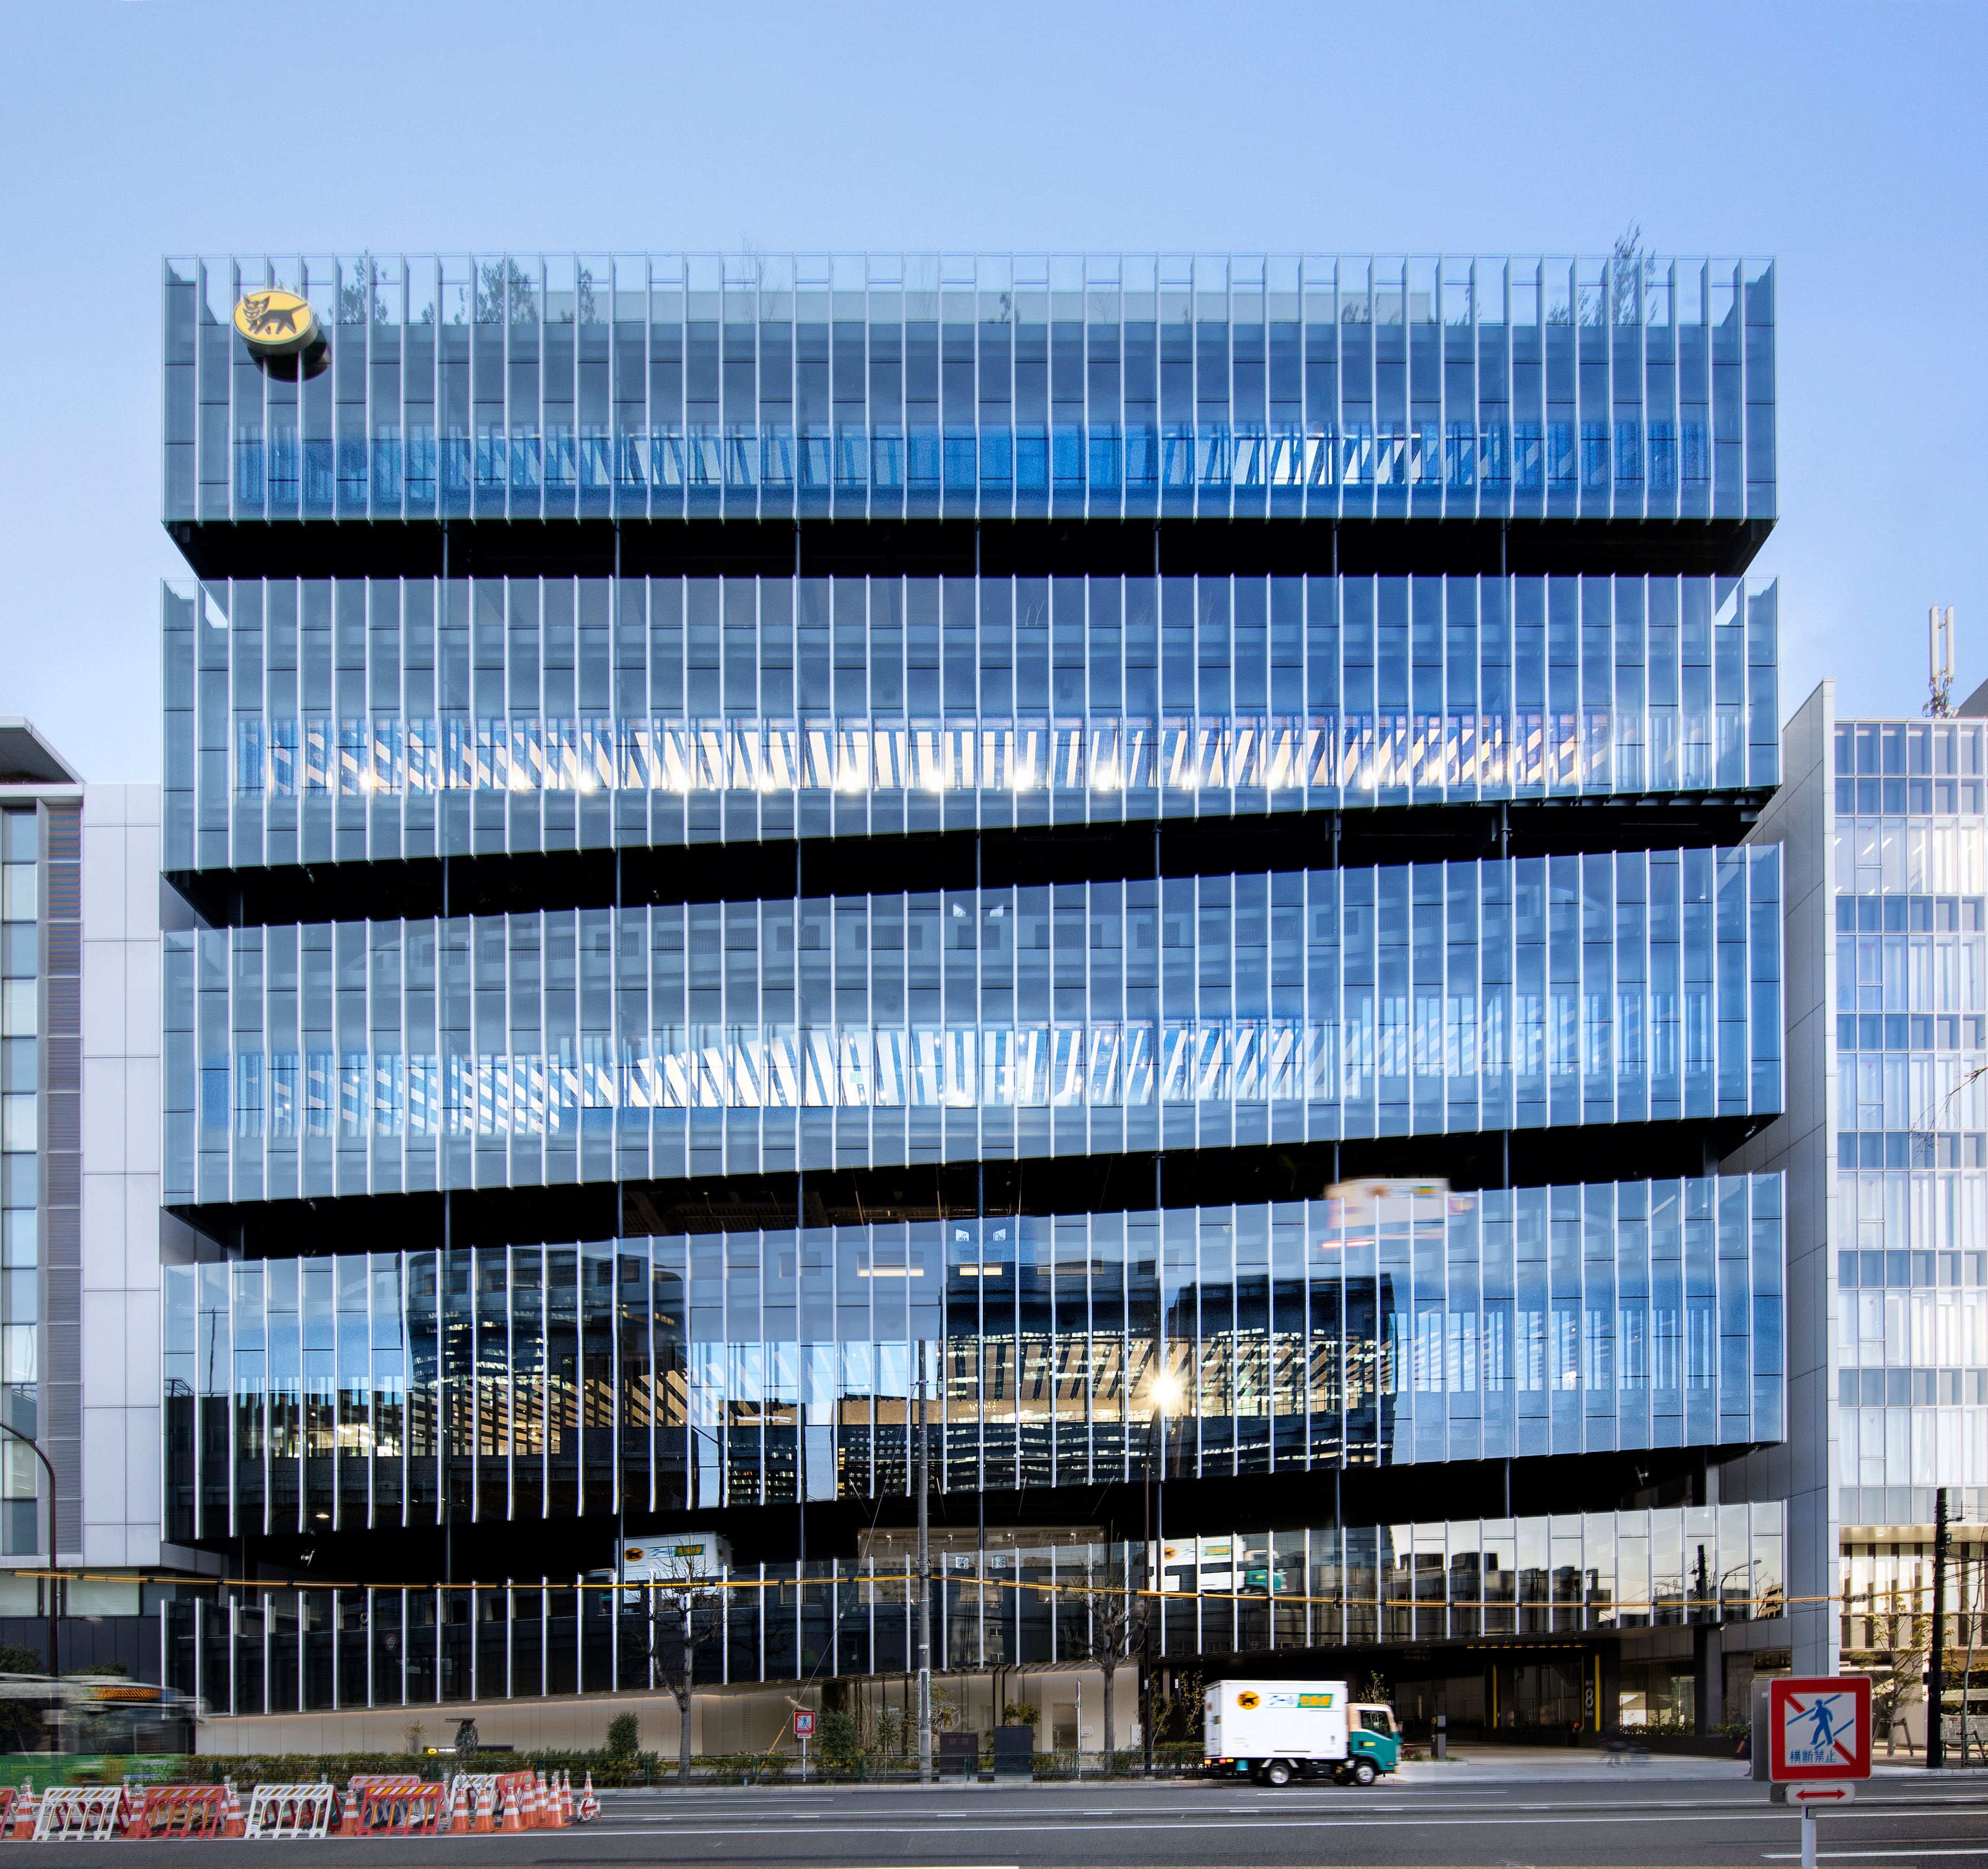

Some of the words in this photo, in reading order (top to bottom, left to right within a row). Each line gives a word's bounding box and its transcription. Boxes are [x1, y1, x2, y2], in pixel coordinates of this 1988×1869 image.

[1585, 1687, 1594, 1708] 8
[1789, 1749, 1837, 1764] 横断禁止
